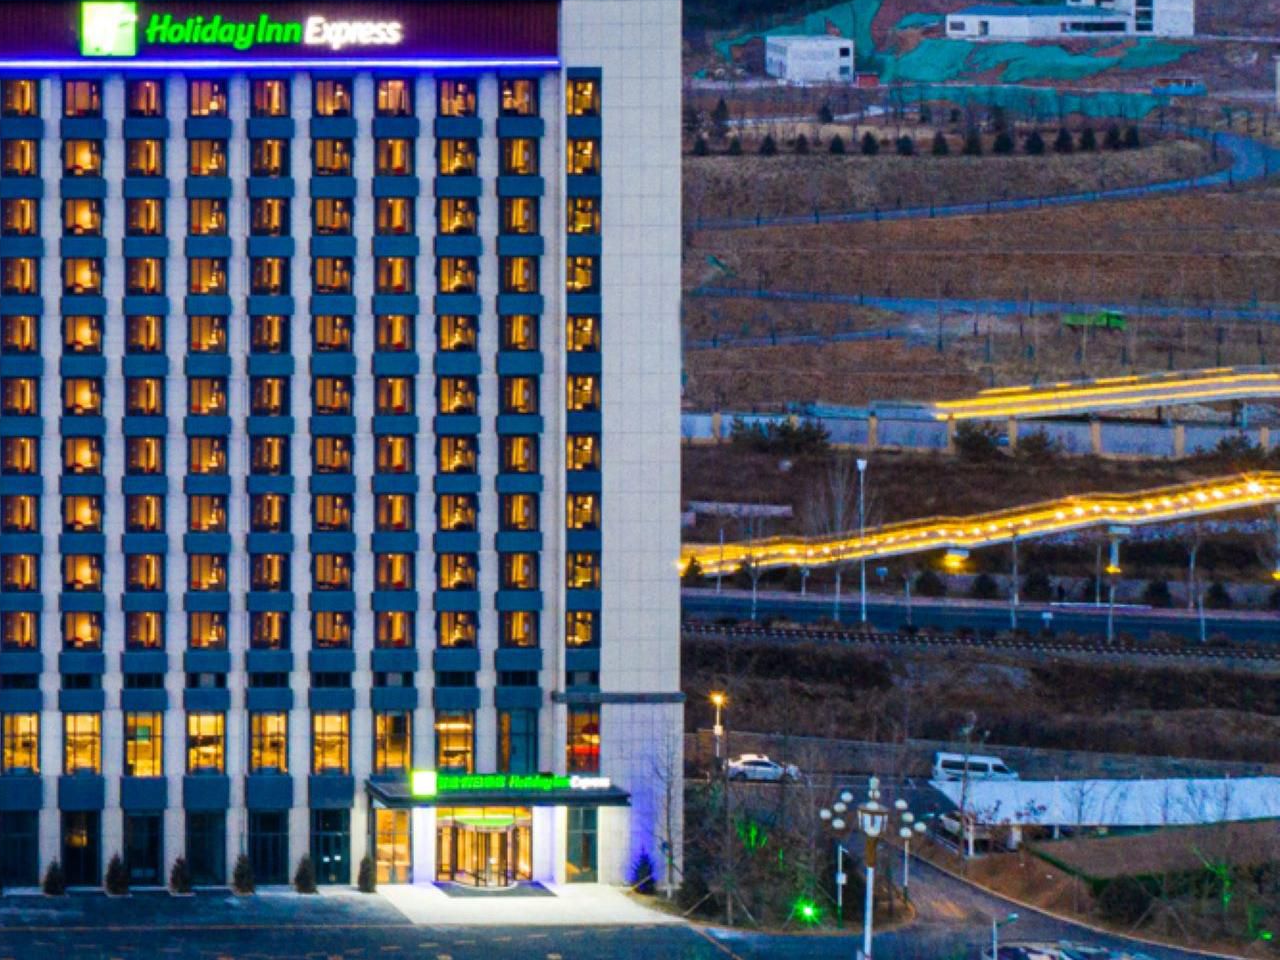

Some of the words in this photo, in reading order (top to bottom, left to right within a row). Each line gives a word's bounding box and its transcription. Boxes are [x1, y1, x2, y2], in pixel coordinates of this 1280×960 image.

[145, 14, 255, 50] Holiday
[256, 14, 302, 43] Inn
[304, 16, 403, 50] Express
